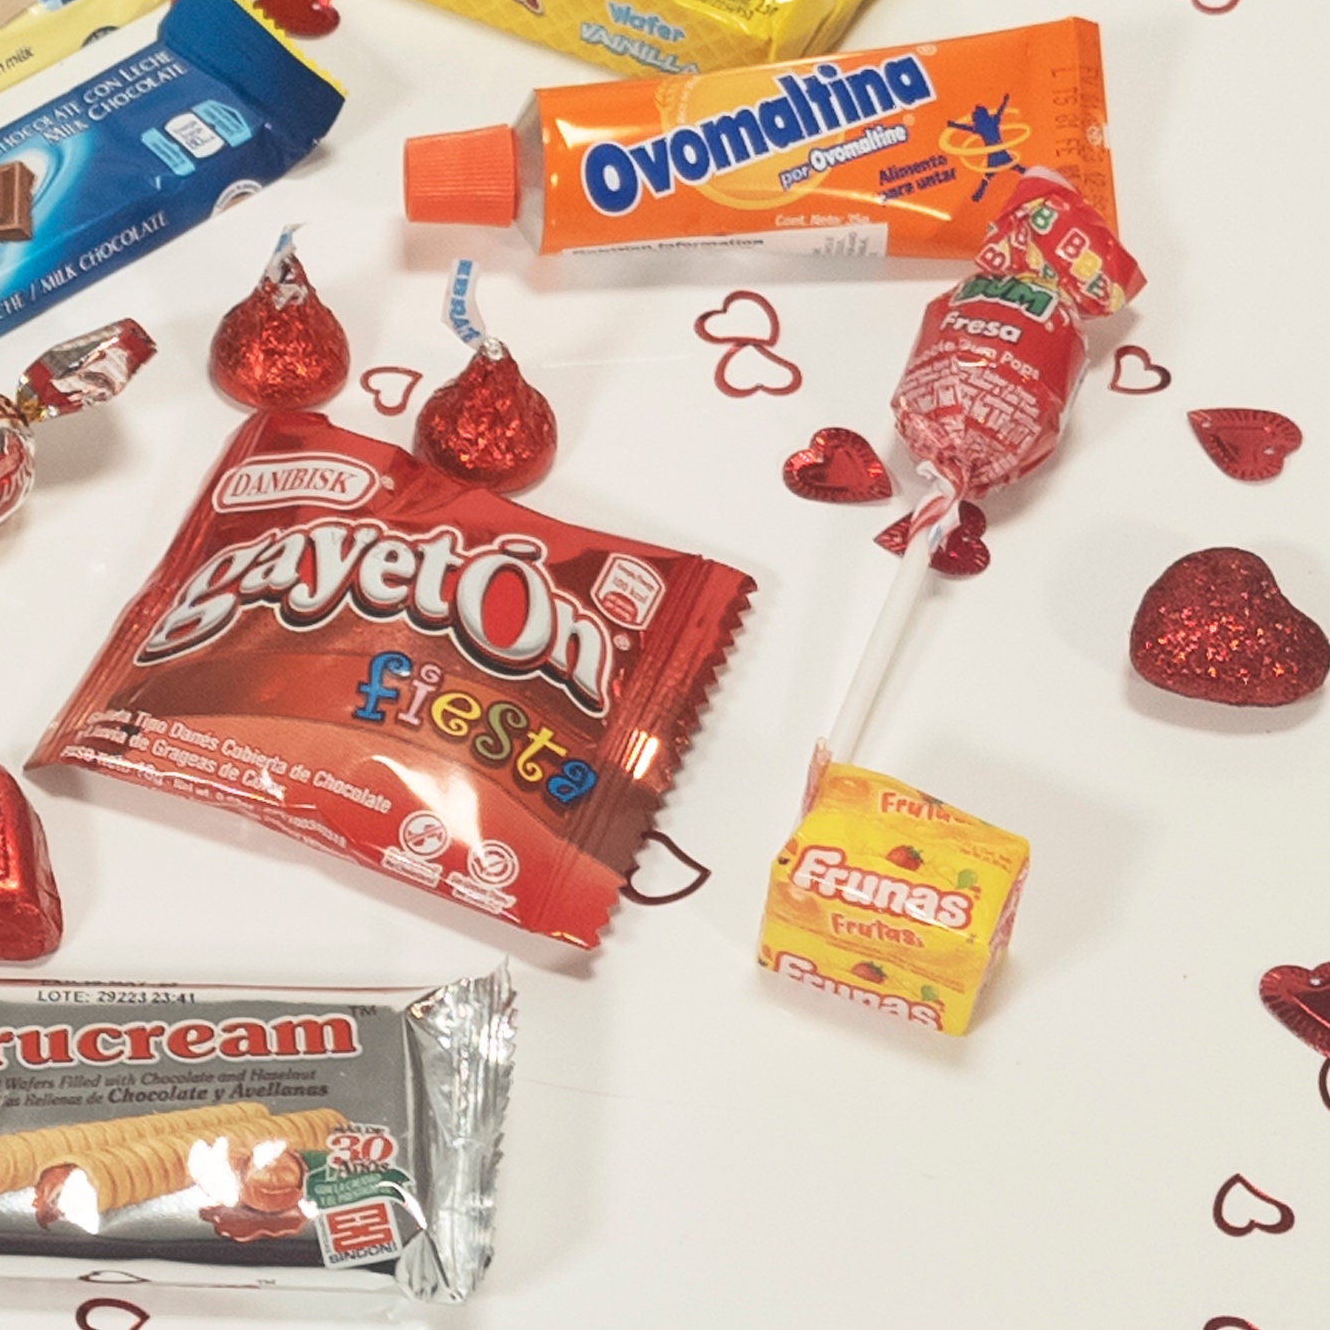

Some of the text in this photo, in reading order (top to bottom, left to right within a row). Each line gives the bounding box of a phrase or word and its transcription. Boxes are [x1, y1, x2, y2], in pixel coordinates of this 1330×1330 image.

[608, 0, 686, 44] Wafer
[5, 45, 36, 70] milk
[81, 75, 122, 106] CON
[584, 55, 933, 213] Ovomaltina
[779, 125, 908, 190] por Ovomaltine
[879, 155, 948, 185] Alimento
[916, 169, 957, 191] untar
[40, 264, 77, 296] MILK
[78, 211, 169, 270] CHOCOLATE
[940, 311, 1023, 343] Fresa
[231, 466, 357, 498] DANIBISK
[353, 650, 598, 805] fiesta
[128, 733, 150, 751] de
[152, 738, 217, 774] Grageas
[217, 761, 239, 782] de
[134, 710, 168, 733] Tipo
[170, 721, 220, 752] Danés
[289, 763, 312, 783] de
[314, 771, 393, 814] Chocolate
[881, 791, 972, 825] Fruta
[794, 848, 970, 929] Frunas
[38, 990, 197, 1005] LOTE: 29223 23:41
[5, 1075, 55, 1094] Wafers
[59, 1073, 101, 1089] Filled
[104, 1072, 135, 1087] with
[140, 1067, 214, 1087] Chocolate
[218, 1068, 247, 1084] and
[250, 1065, 317, 1083] Hazelnut
[86, 1092, 104, 1105] de
[107, 1085, 209, 1105] Chocolate
[212, 1085, 227, 1102] y
[230, 1081, 330, 1100] Avellanas
[331, 1134, 394, 1165] 30
